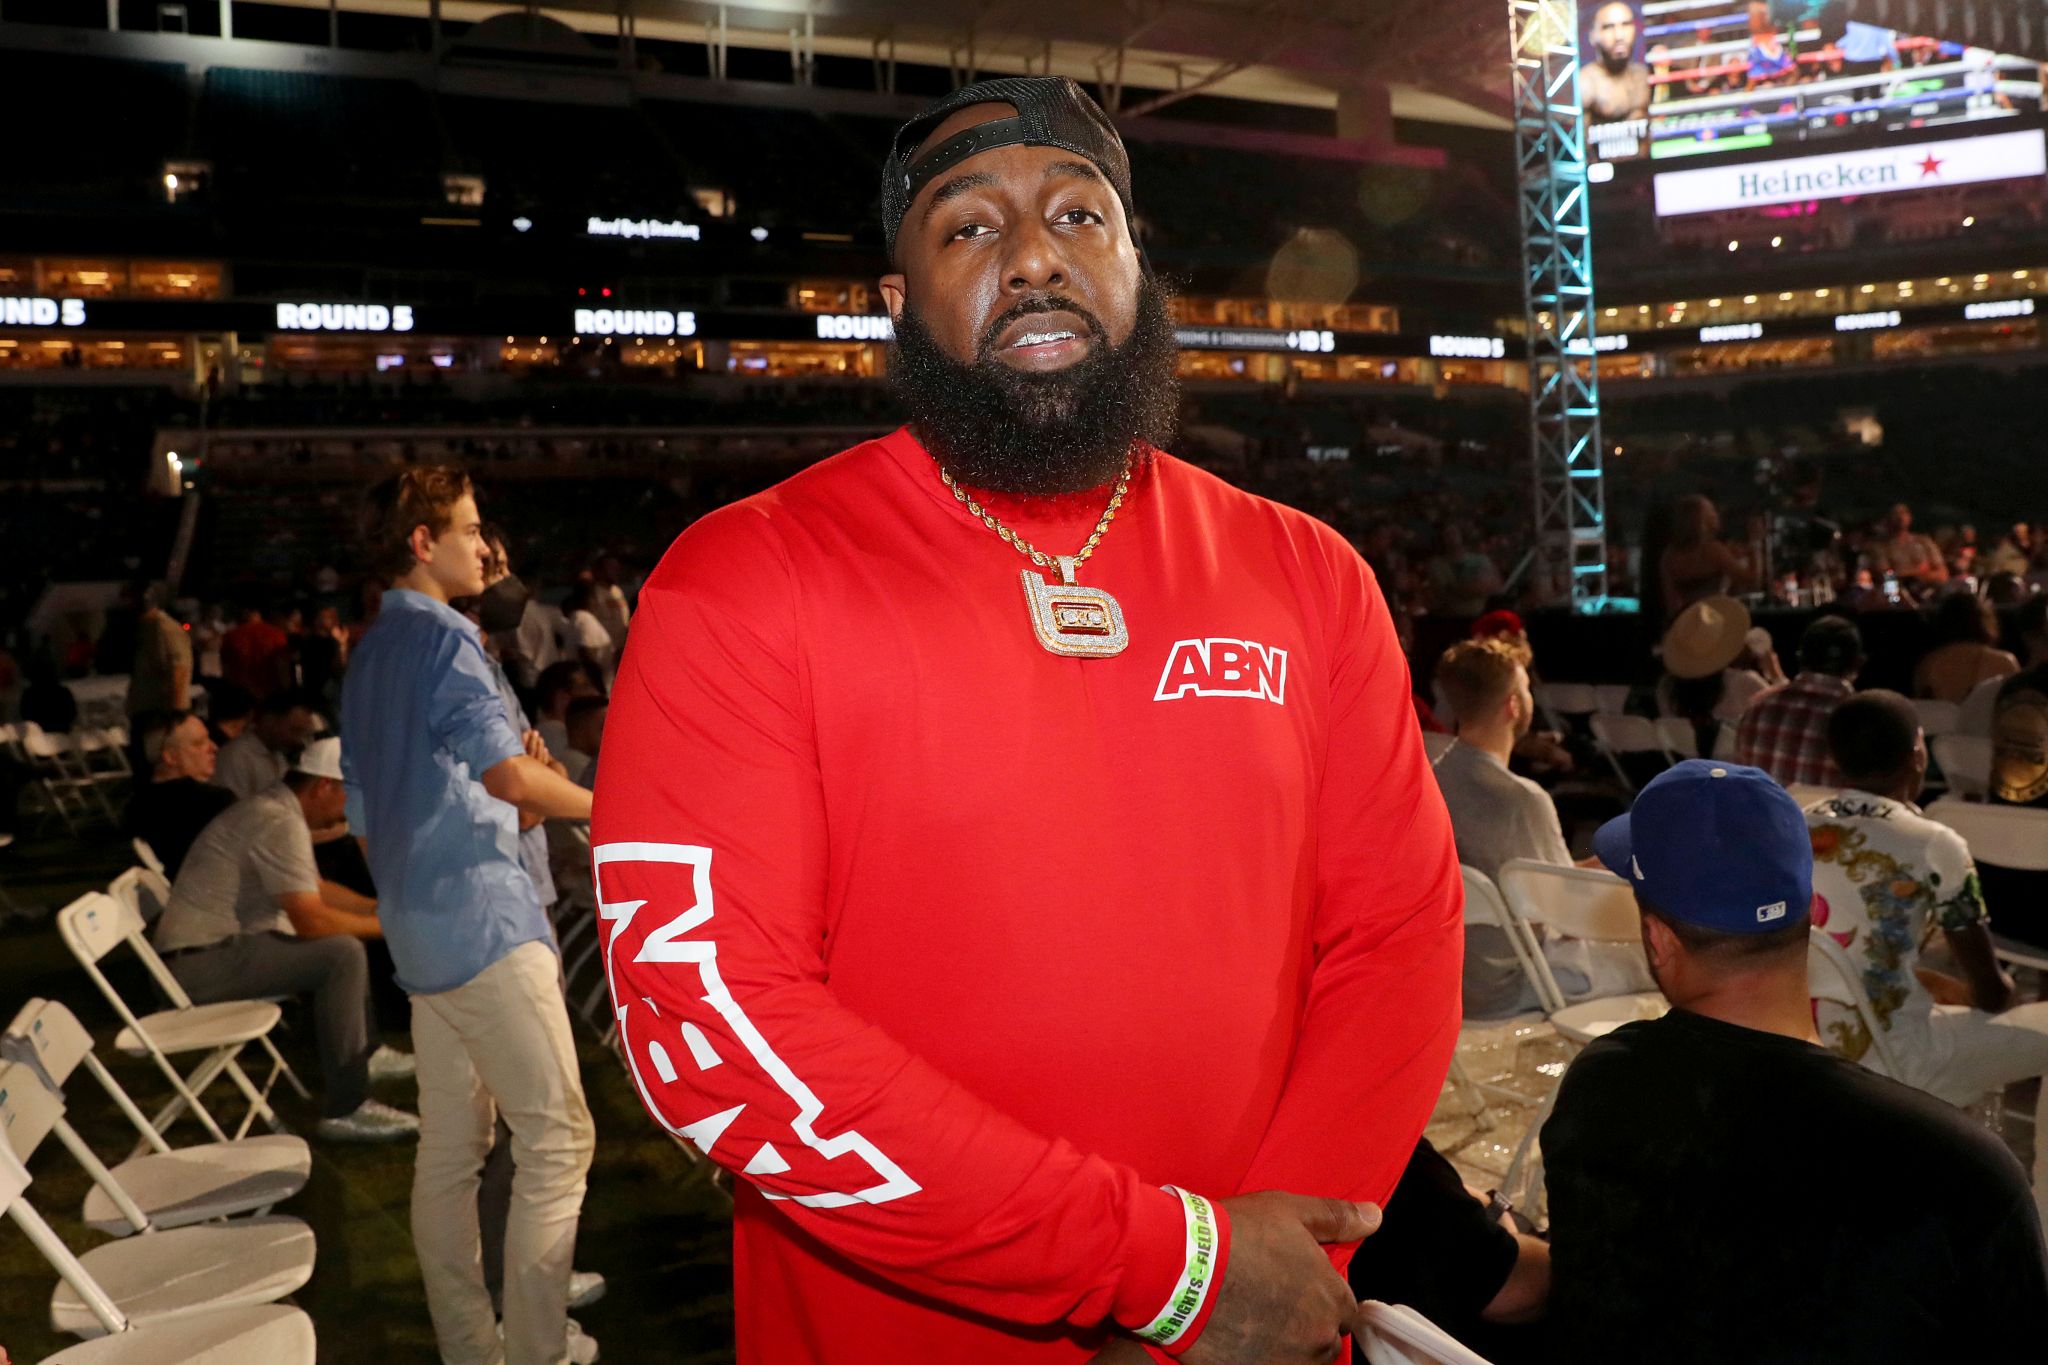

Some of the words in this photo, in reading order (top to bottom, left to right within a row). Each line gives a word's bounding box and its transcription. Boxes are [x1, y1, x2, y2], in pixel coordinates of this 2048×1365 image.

[1738, 163, 1898, 198] Heineken
[62, 299, 86, 326] 5
[276, 303, 390, 331] ROUND
[393, 305, 414, 331] 5
[574, 309, 675, 335] ROUND
[677, 311, 696, 336] 5
[816, 314, 896, 339] ROUN
[1153, 638, 1287, 705] ABN
[1189, 1191, 1210, 1224] ACC
[1196, 1225, 1212, 1265] FIELD
[1167, 1277, 1204, 1327] RIGHTS
